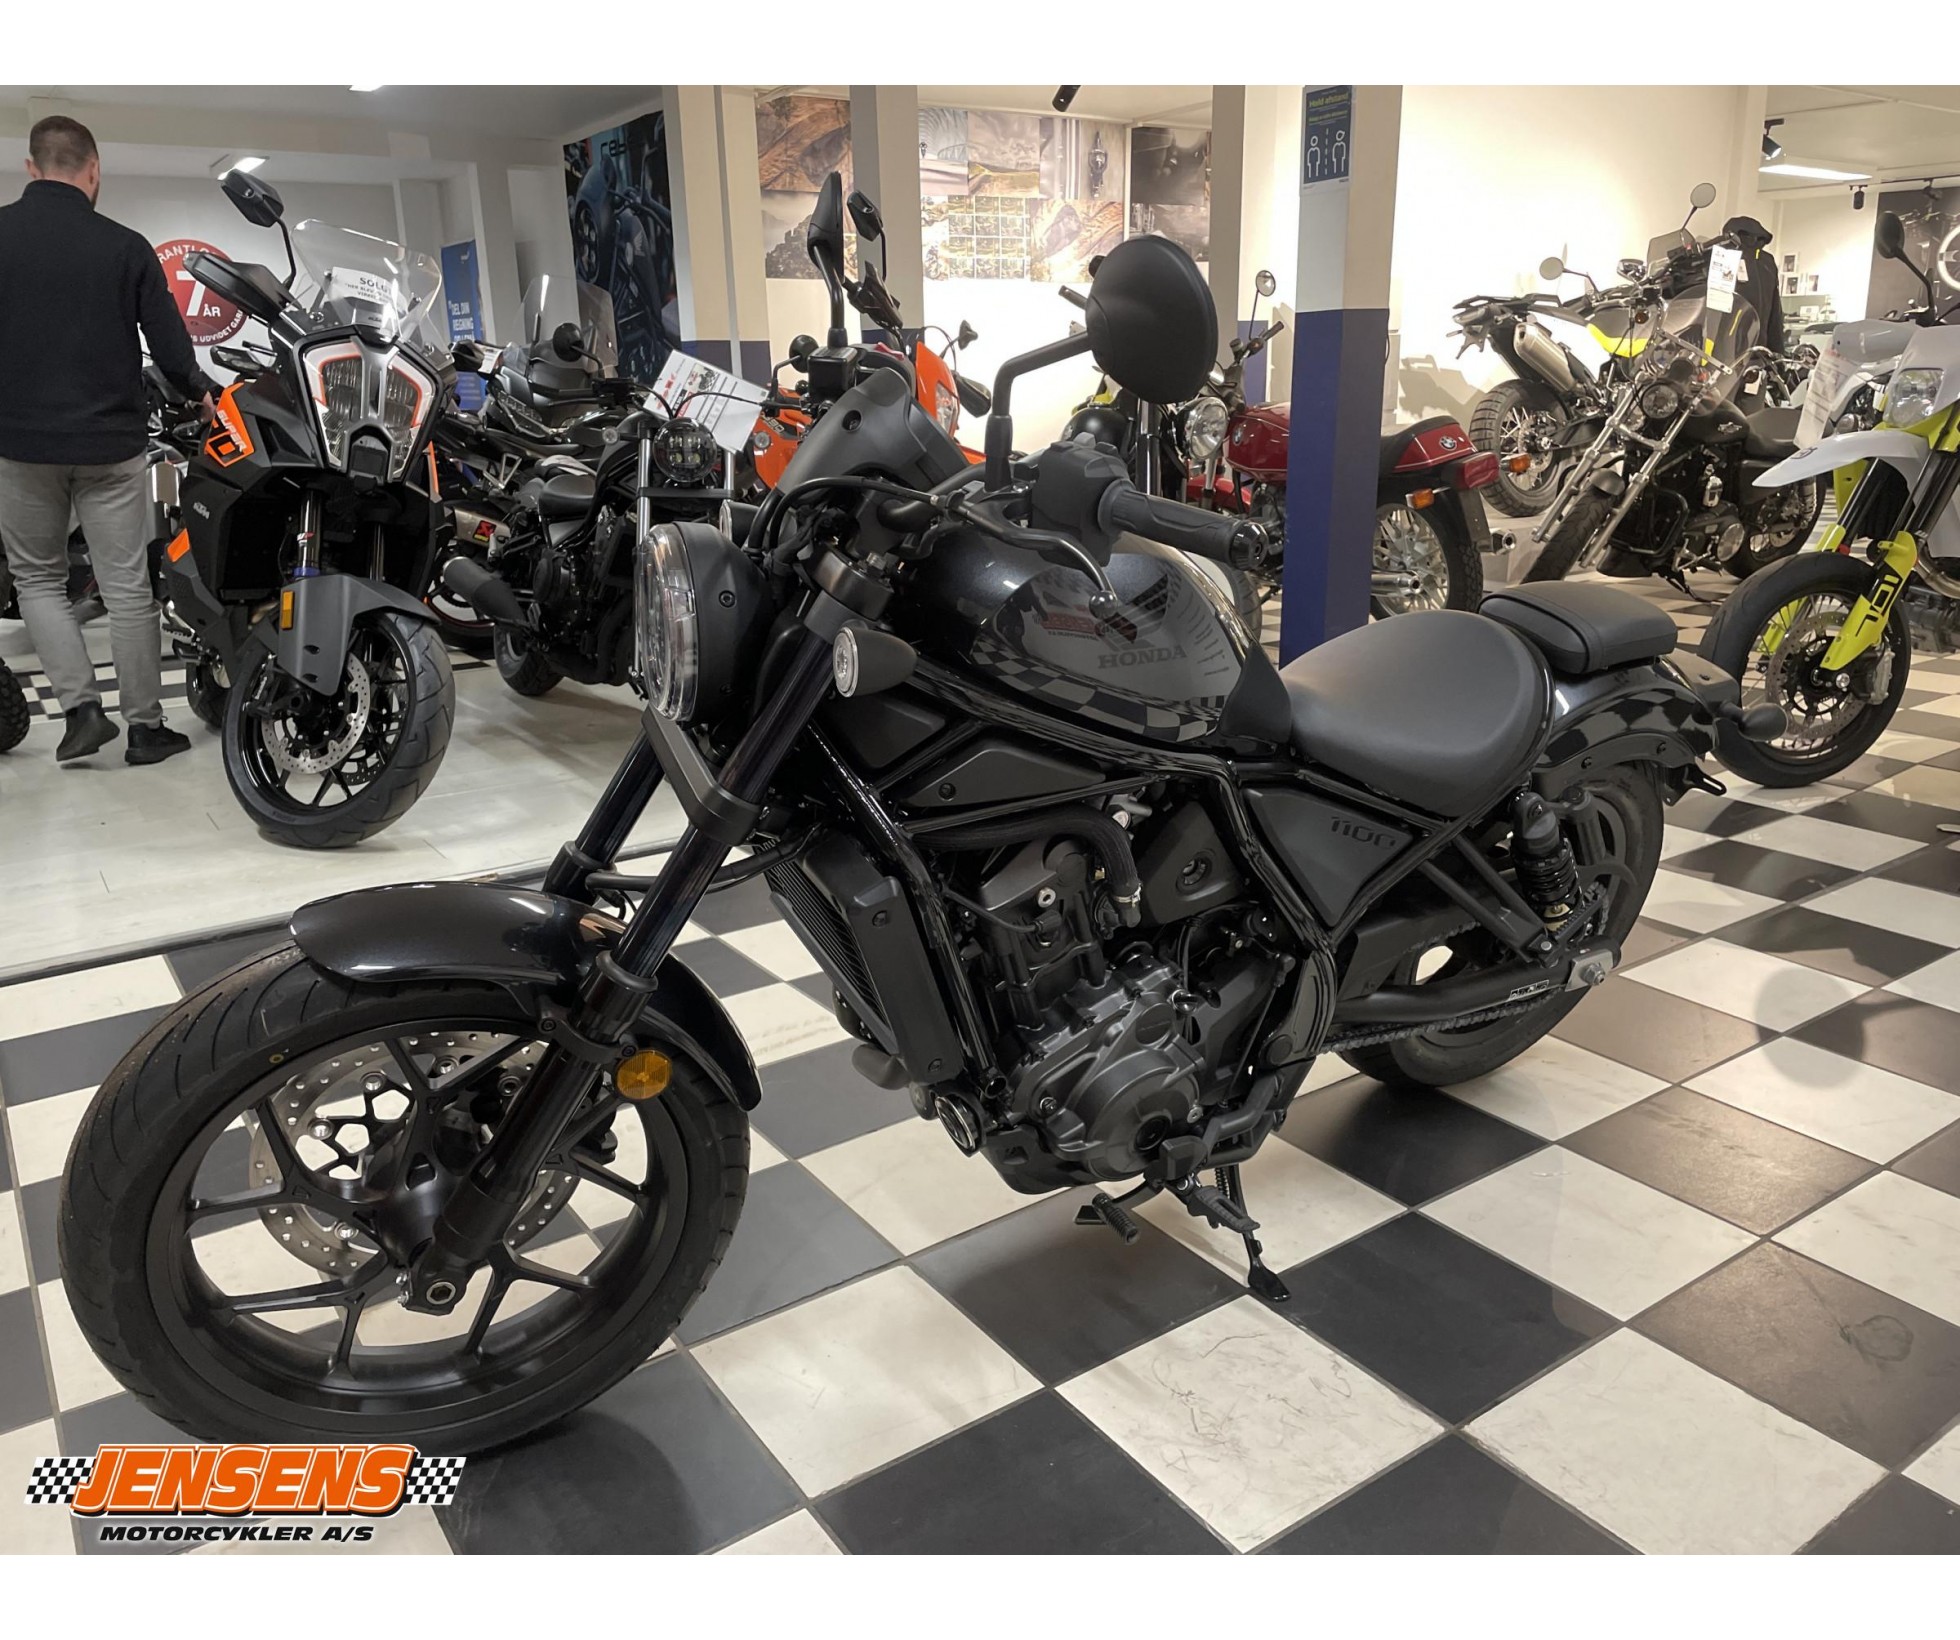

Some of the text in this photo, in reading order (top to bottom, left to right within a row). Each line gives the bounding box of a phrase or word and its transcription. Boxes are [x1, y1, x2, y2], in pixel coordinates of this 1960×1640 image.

[157, 244, 196, 264] RANTI
[176, 270, 207, 317] 7
[203, 303, 221, 317] ÅR
[200, 327, 232, 342] UDVIDET
[216, 409, 247, 453] SUPER
[1098, 645, 1187, 669] HONDA
